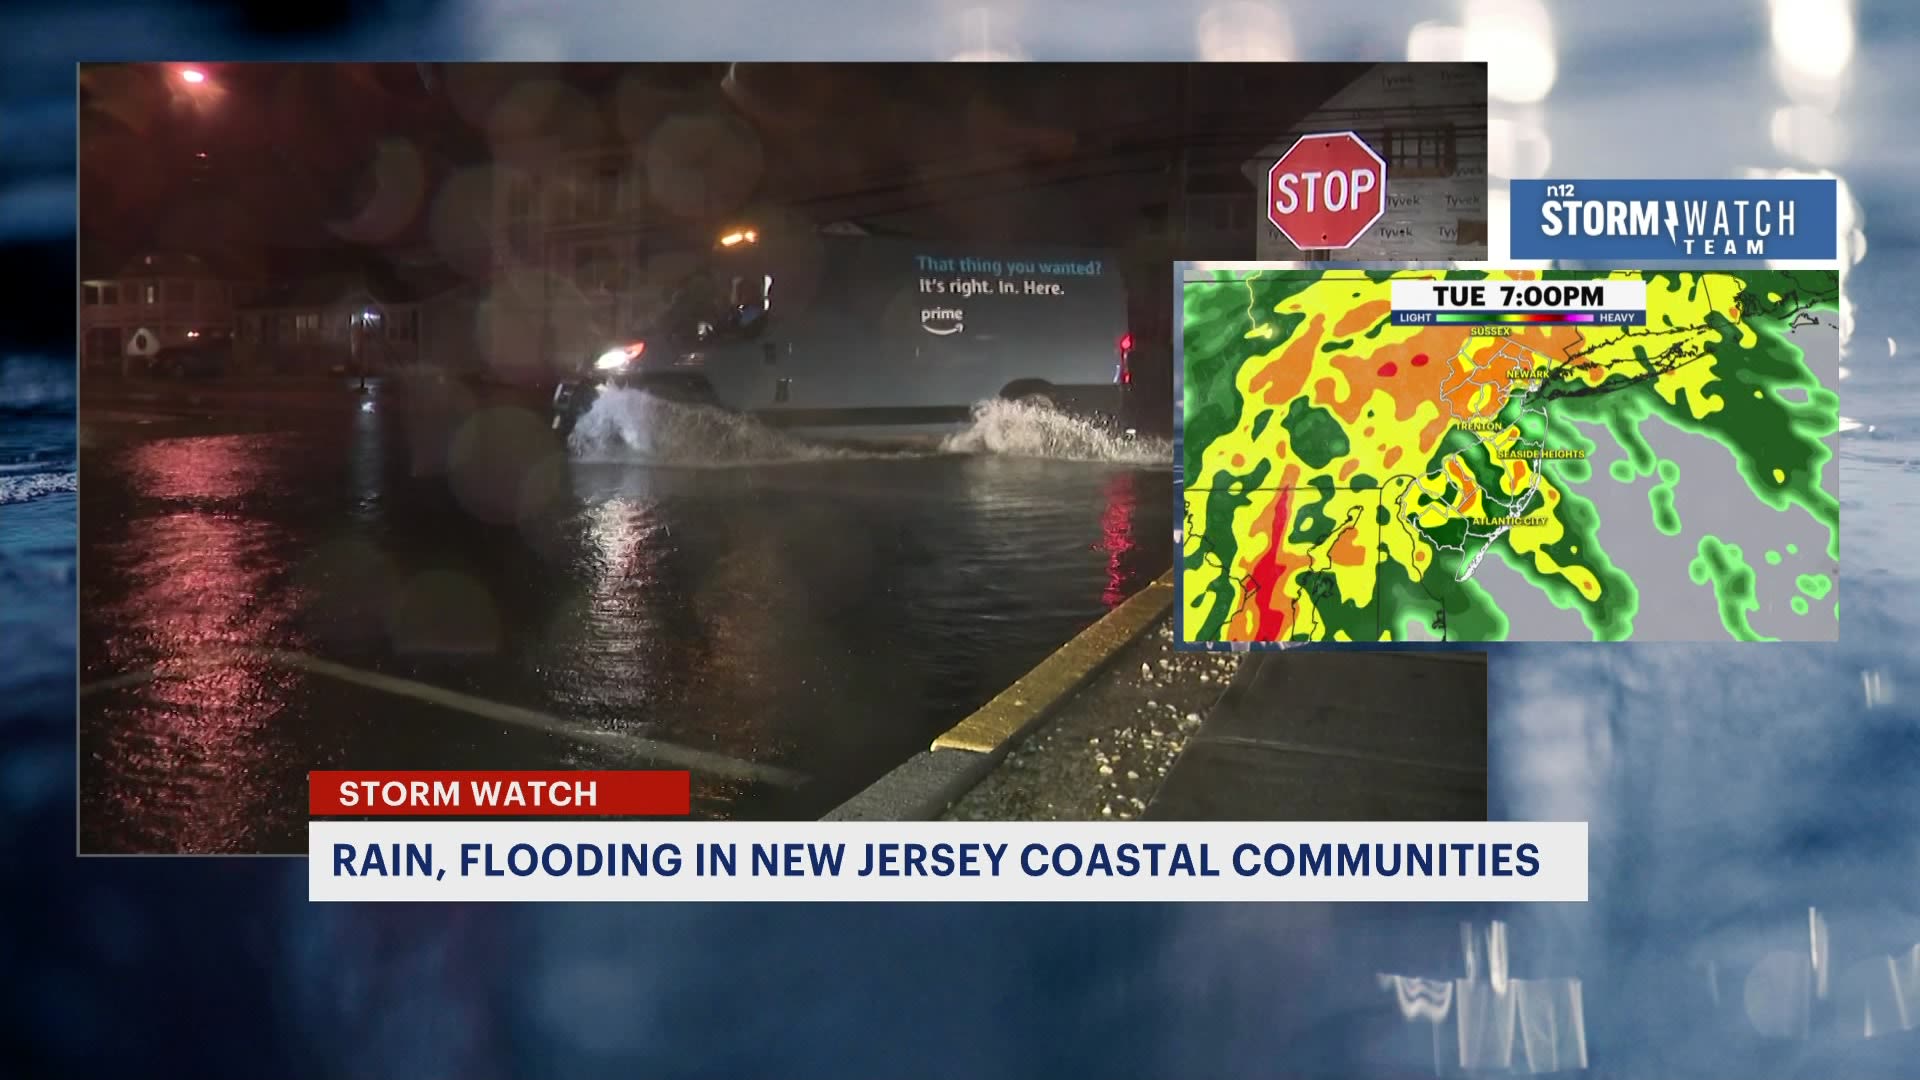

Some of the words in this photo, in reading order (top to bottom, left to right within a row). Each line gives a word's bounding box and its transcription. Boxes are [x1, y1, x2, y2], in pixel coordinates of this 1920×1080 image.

[1276, 168, 1376, 214] STOP
[916, 255, 955, 272] That
[960, 257, 1001, 275] thing
[1006, 262, 1035, 276] you
[1039, 261, 1102, 275] wanted?
[919, 279, 945, 293] It's
[949, 280, 993, 297] right.
[999, 281, 1019, 293] In.
[1024, 281, 1065, 295] Here.
[920, 307, 963, 322] prime
